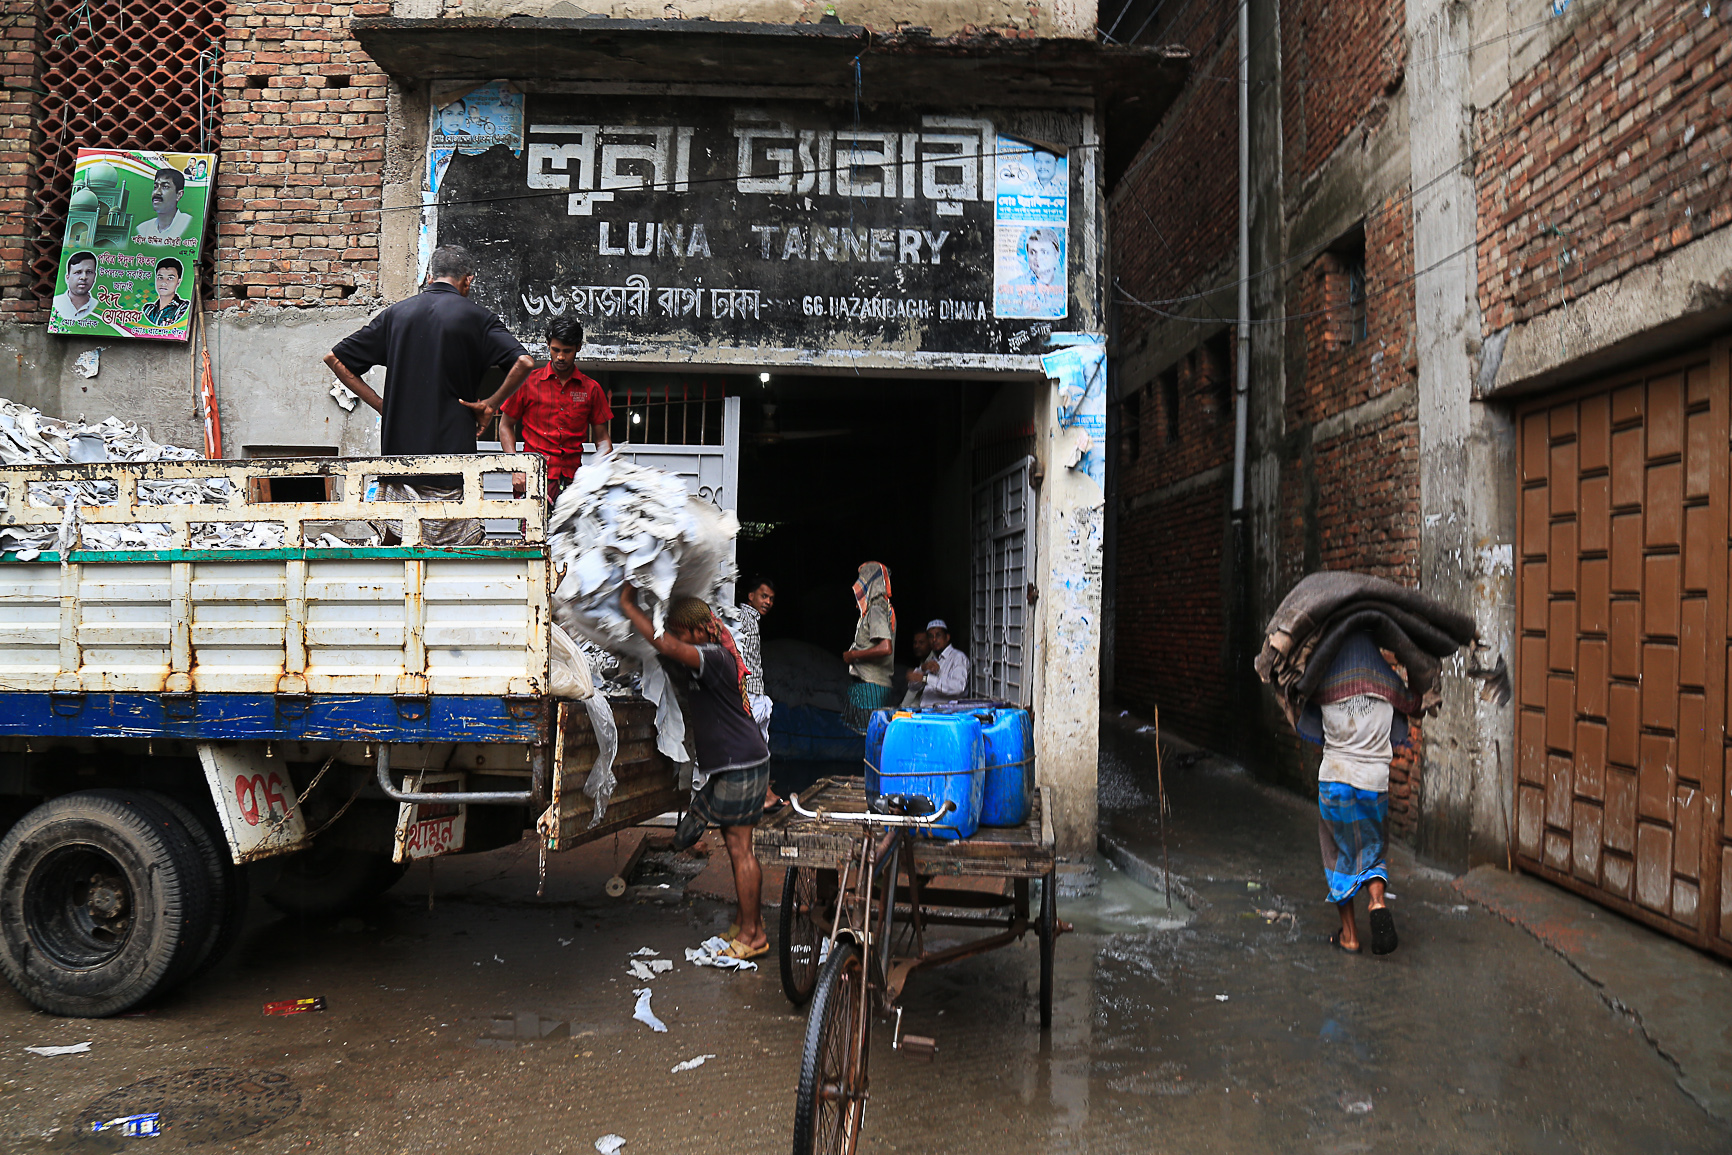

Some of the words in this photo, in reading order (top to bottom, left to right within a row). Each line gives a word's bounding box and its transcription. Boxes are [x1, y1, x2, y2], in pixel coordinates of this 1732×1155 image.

[527, 125, 694, 216] লুনা
[733, 113, 995, 217] ট্যানারী
[599, 222, 711, 257] LUNA
[751, 224, 950, 264] TANNERY
[97, 251, 116, 265] পবিত্র
[117, 252, 135, 268] ঈদুল
[126, 268, 153, 281] সবাইকে
[97, 285, 123, 308] ঈদ
[113, 280, 134, 293] জানাই
[571, 274, 651, 317] হাজারী
[102, 309, 143, 325] মোবারক
[407, 815, 456, 852] থামুন
